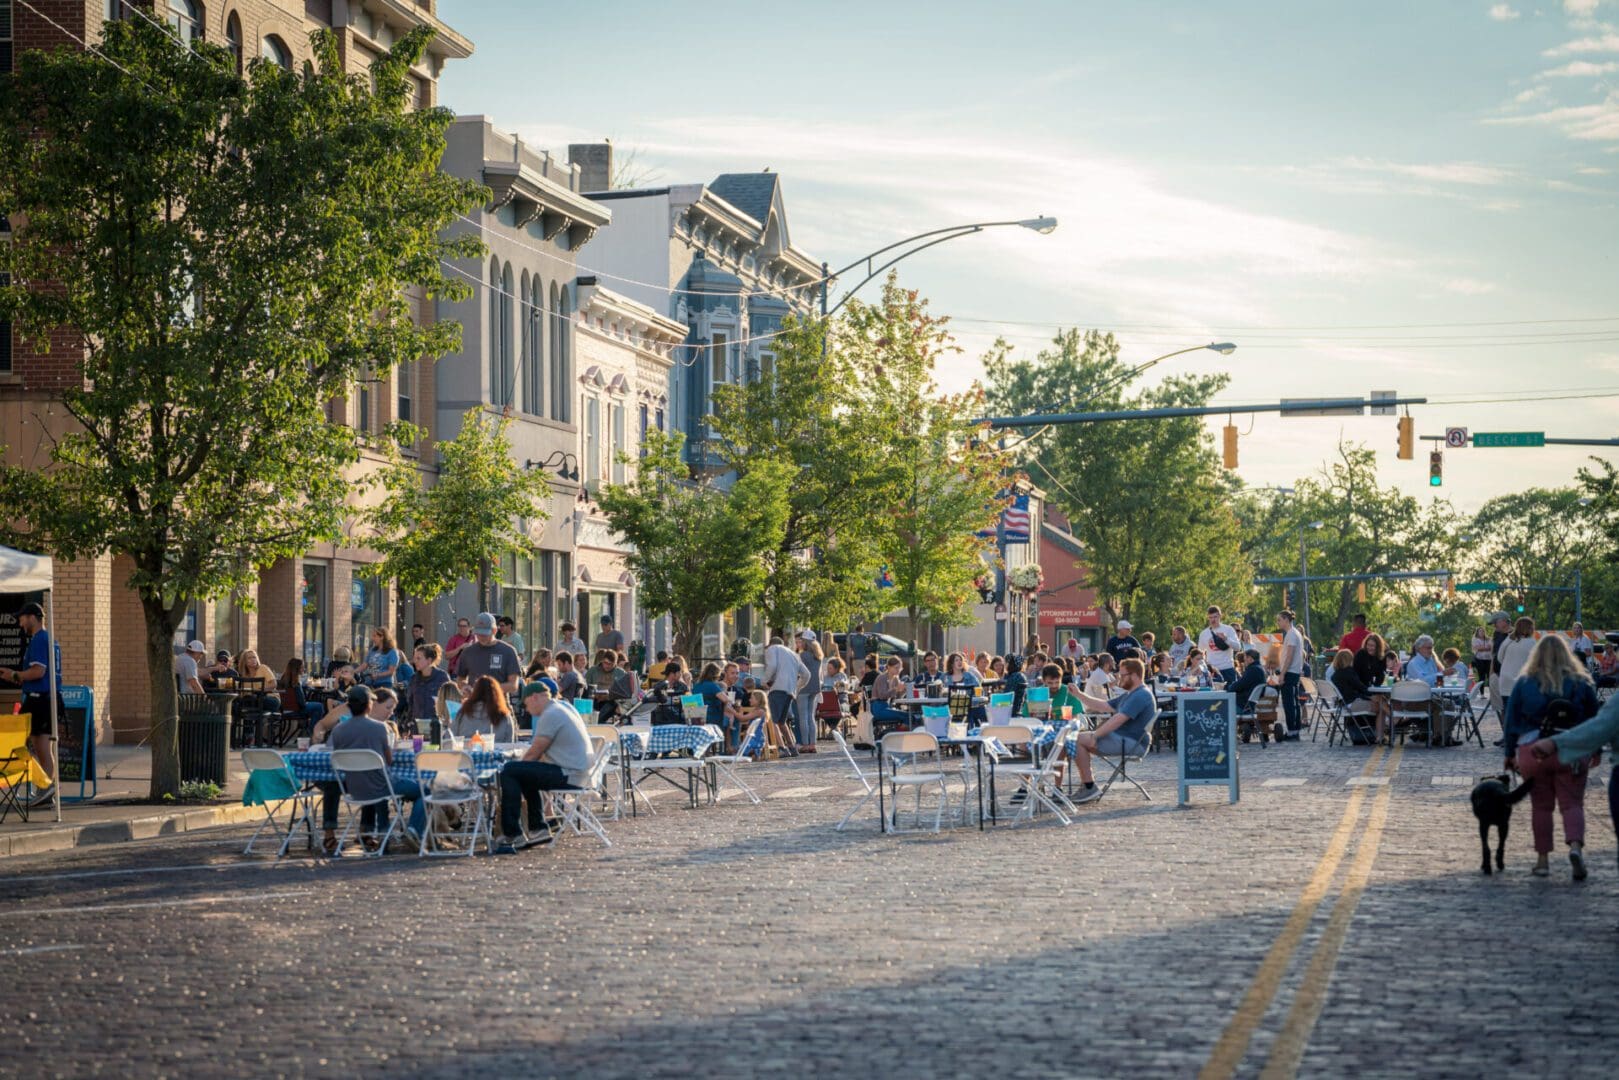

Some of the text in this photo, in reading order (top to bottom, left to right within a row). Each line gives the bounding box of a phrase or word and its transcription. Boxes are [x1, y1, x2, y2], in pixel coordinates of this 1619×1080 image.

[1479, 435, 1538, 446] BEECH ST
[59, 690, 82, 699] GHT
